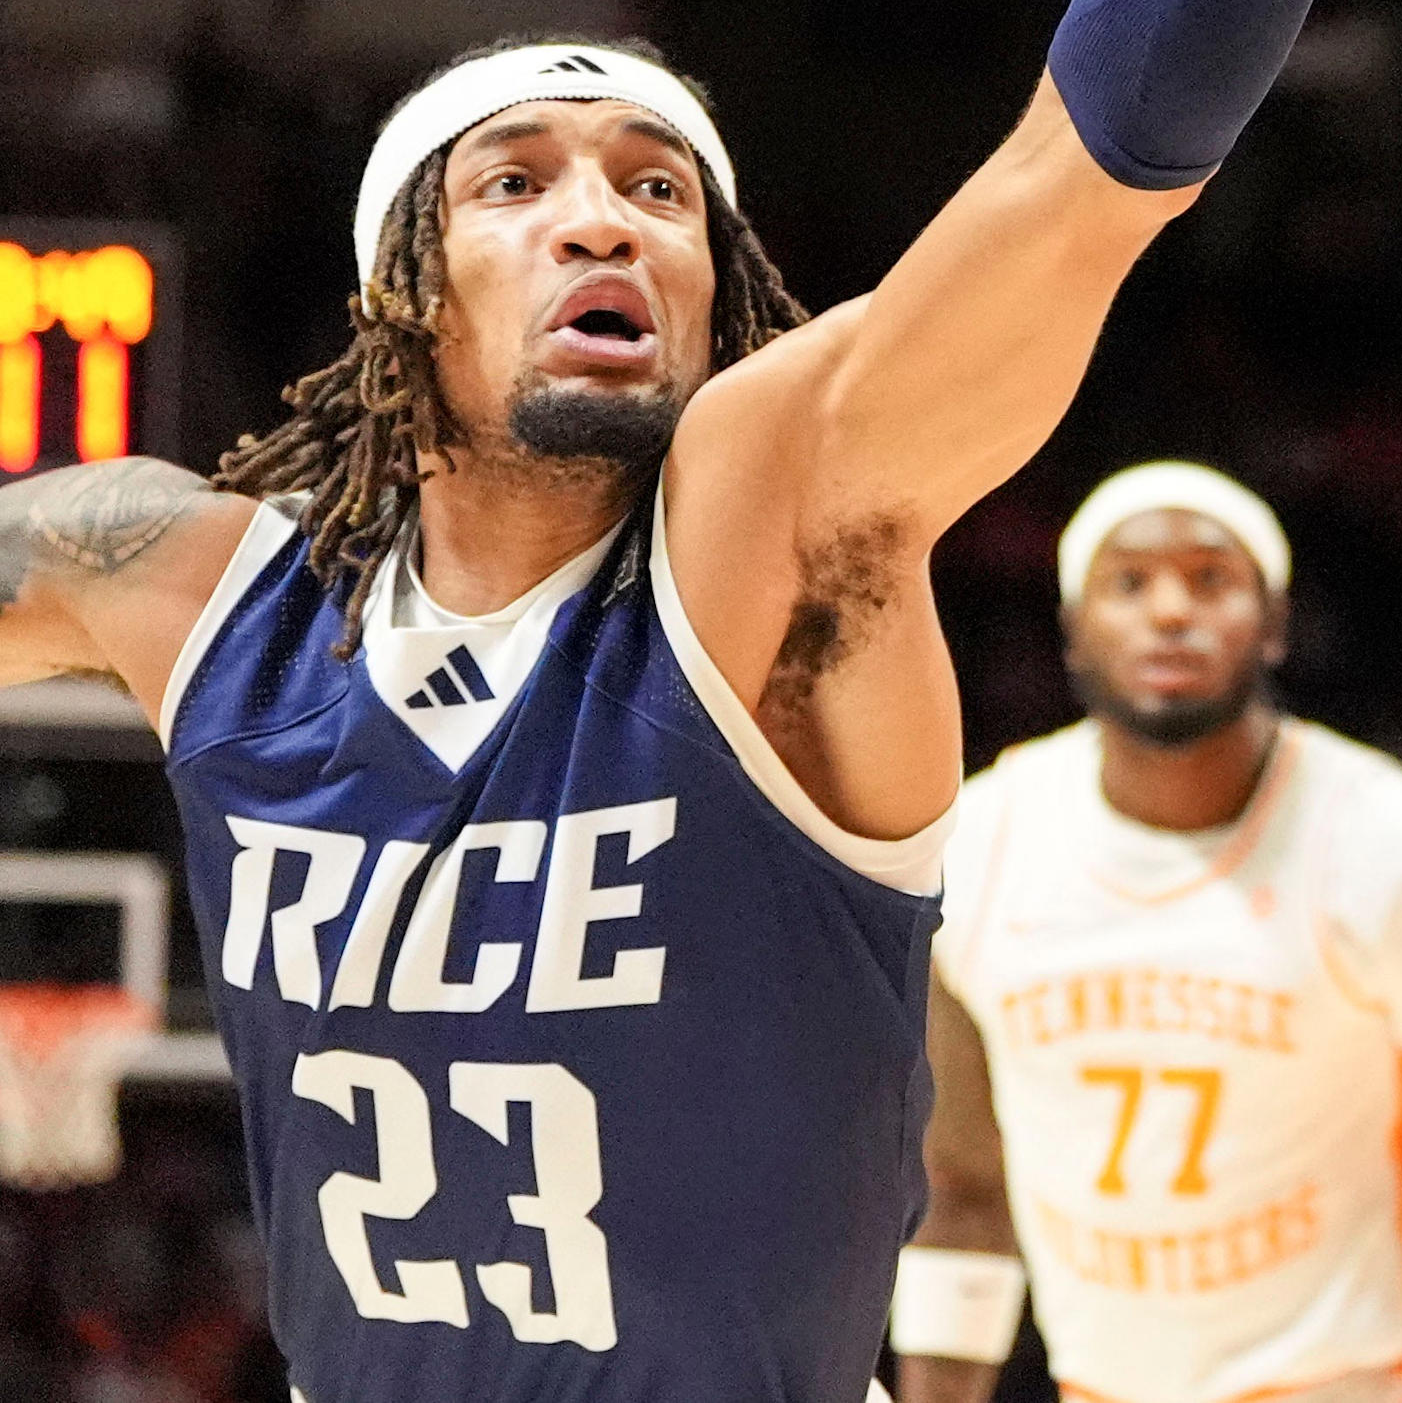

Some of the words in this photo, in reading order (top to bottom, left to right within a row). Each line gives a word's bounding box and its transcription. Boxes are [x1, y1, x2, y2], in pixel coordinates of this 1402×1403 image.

[221, 796, 678, 1014] RICE
[291, 1048, 618, 1353] 23
[1079, 1065, 1224, 1196] 77
